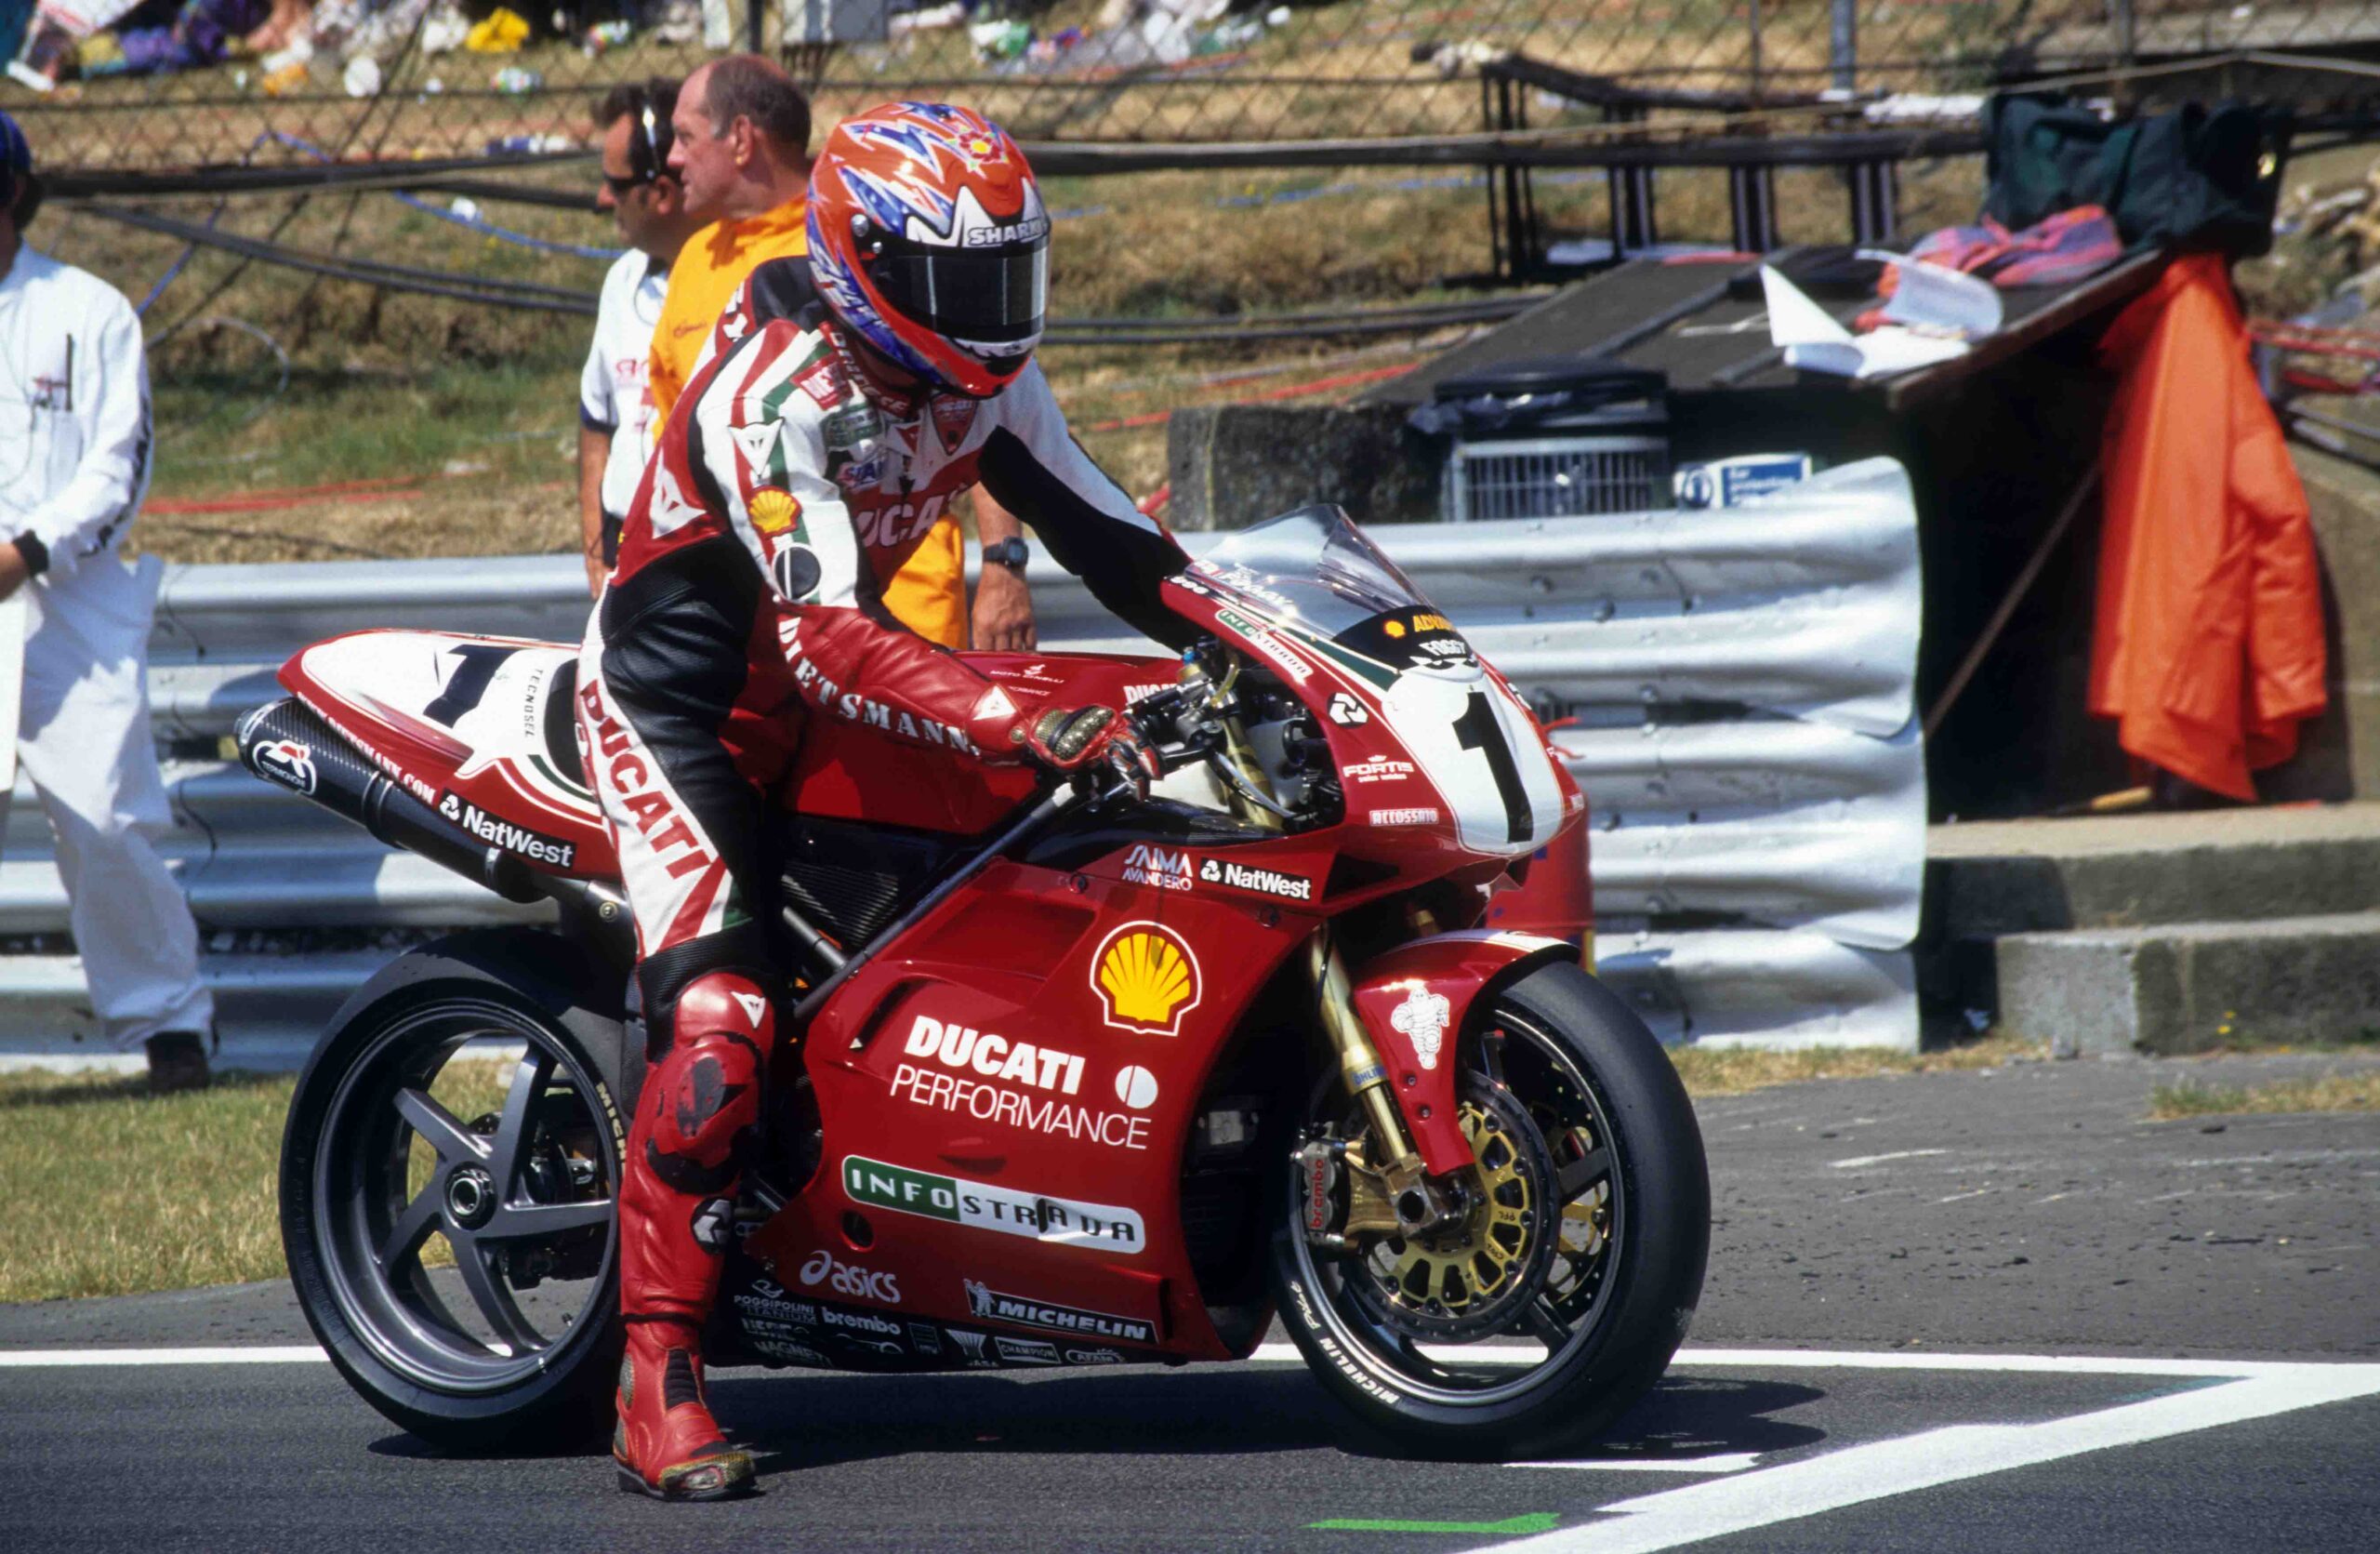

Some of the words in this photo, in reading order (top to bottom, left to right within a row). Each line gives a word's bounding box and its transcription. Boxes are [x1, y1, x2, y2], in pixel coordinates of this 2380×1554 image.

[579, 679, 712, 880] DUCATI
[1342, 761, 1414, 777] FORTIS
[1451, 692, 1533, 843] 1
[464, 805, 574, 868] NatWest
[1124, 844, 1193, 878] SAIMA
[1122, 868, 1193, 891] AVANDERO
[1224, 863, 1311, 899] NatWest
[904, 1015, 1086, 1096] DUCATI
[890, 1064, 1152, 1149] PERFORMANCE
[852, 1169, 1135, 1242] INFOSTRADA
[1310, 1160, 1324, 1229] brembo
[734, 1295, 814, 1314] POGGIPOLINI
[822, 1307, 901, 1335] brembo
[998, 1302, 1147, 1339] MICHELIN
[1001, 1344, 1054, 1359] CHAMPION
[1319, 1337, 1400, 1404] MICHELIN
